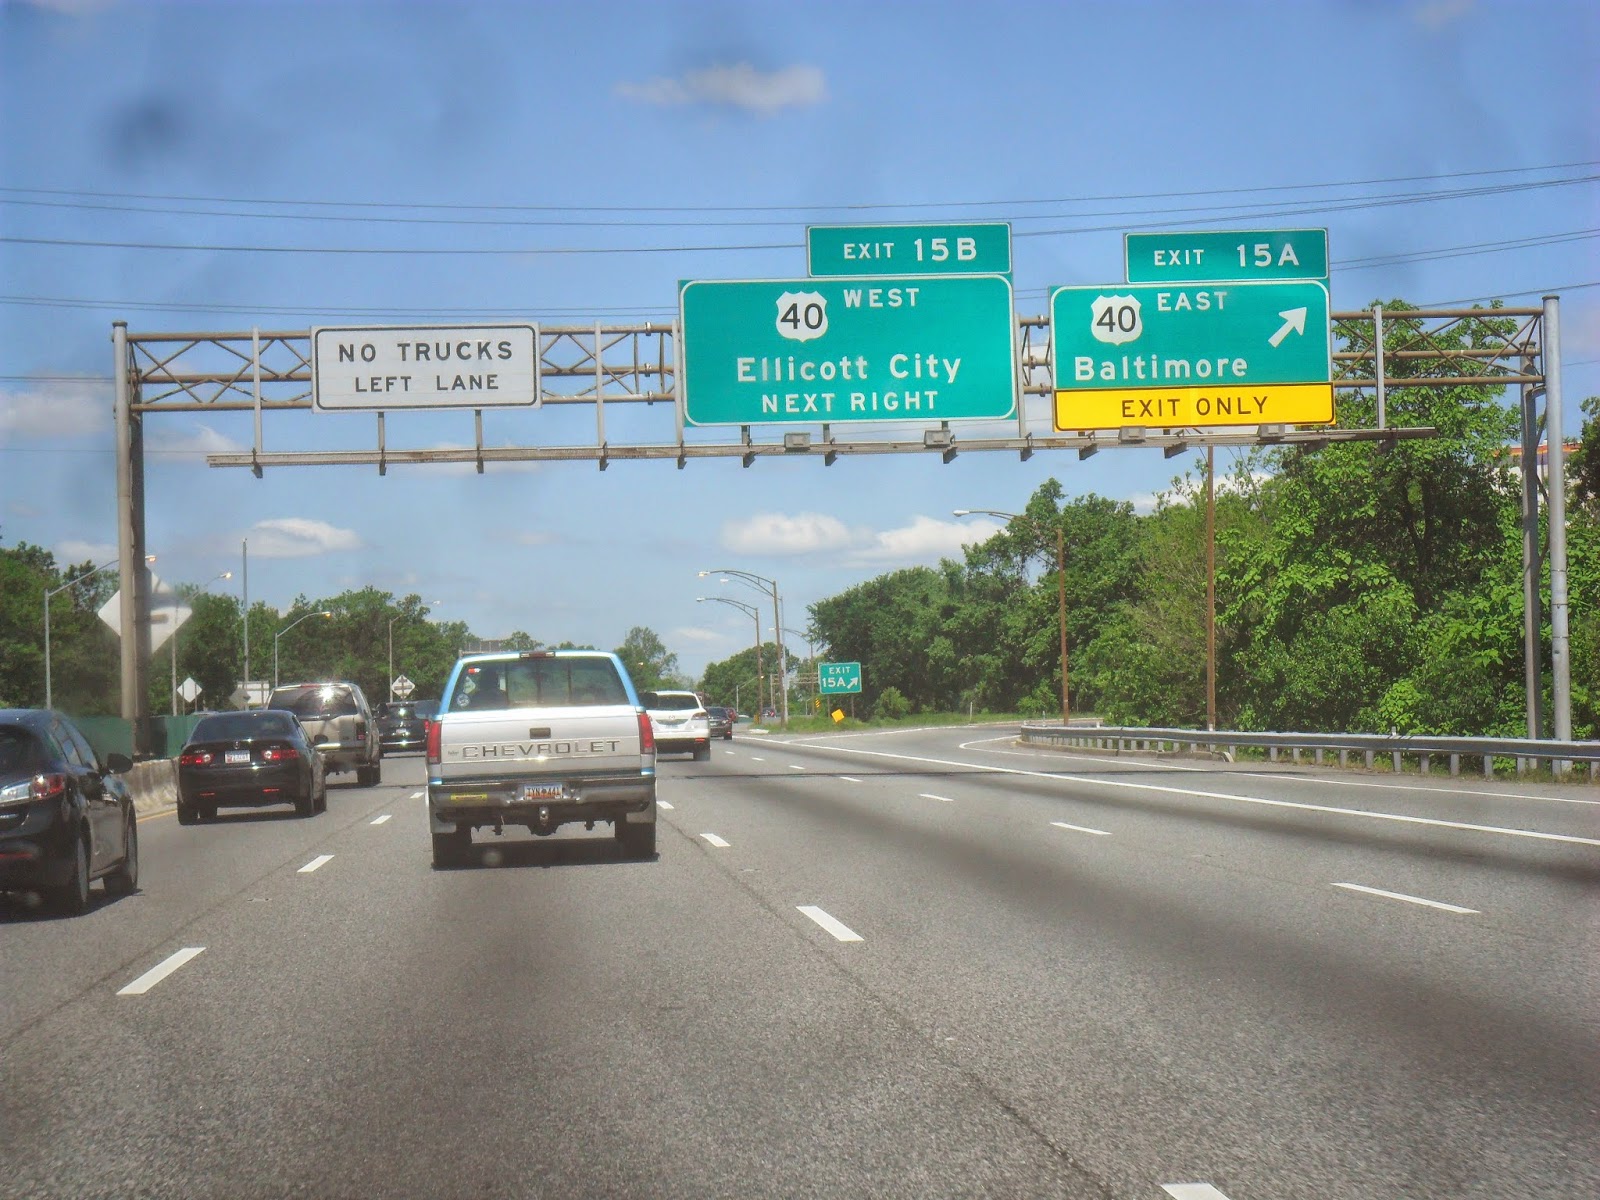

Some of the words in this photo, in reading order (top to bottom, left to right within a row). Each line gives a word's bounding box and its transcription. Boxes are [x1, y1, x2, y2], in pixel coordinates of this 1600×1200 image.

[844, 242, 894, 259] EXIT
[914, 237, 977, 261] 15B
[1154, 249, 1204, 266] EXIT
[1237, 244, 1300, 267] 15A
[844, 288, 920, 308] WEST
[1158, 291, 1228, 311] EAST
[780, 303, 823, 329] 40
[1096, 306, 1136, 332] 40
[339, 343, 376, 362] NO
[397, 341, 512, 361] TRUCKS
[737, 356, 868, 382] Ellicott
[889, 353, 961, 383] City
[1074, 354, 1248, 381] Baltimore
[356, 376, 412, 392] LEFT
[436, 374, 499, 390] LANE
[763, 393, 835, 413] NEXT
[851, 391, 938, 411] RIGHT
[1122, 399, 1180, 418] EXIT
[1196, 396, 1268, 415] ONLY
[822, 677, 846, 687] 15A
[462, 740, 620, 758] CHEVROLET
